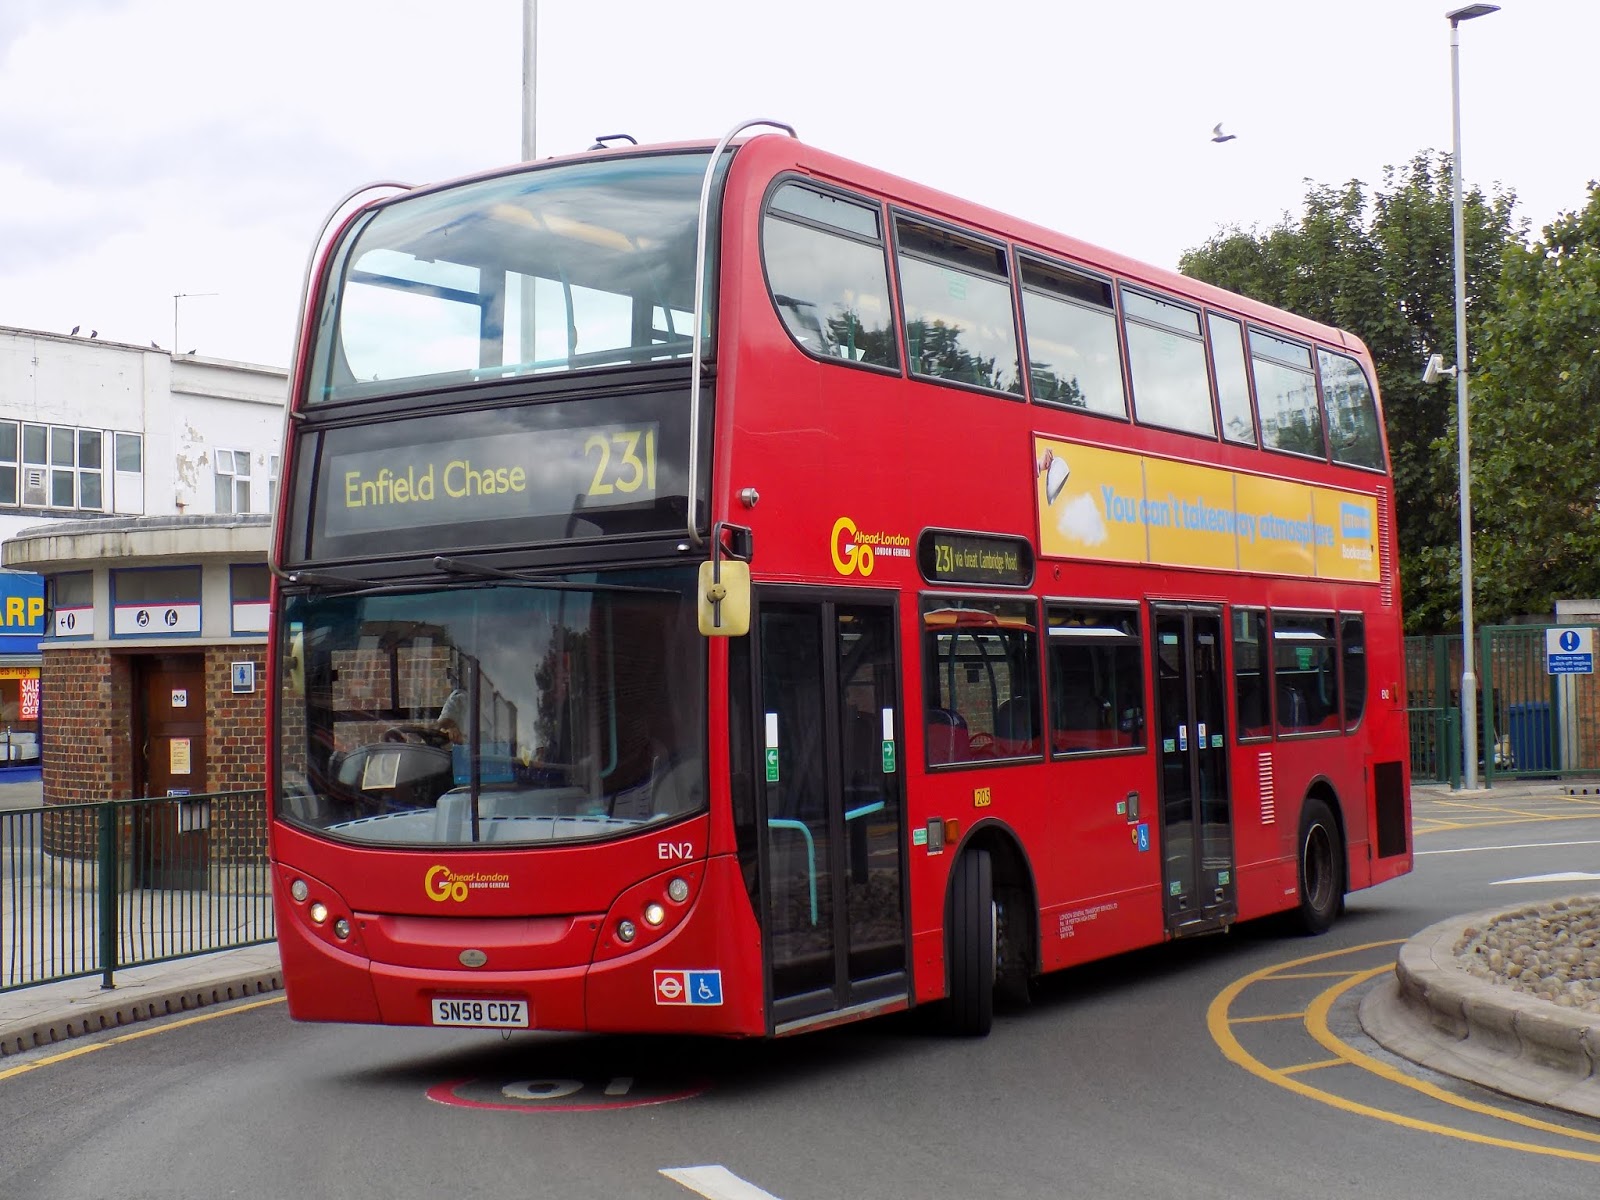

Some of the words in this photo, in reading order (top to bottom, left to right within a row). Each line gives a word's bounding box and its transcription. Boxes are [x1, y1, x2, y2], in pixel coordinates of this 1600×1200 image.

[584, 428, 657, 497] 231
[345, 464, 434, 508] Enfield
[443, 460, 526, 498] Chase
[1101, 484, 1136, 523] You
[1139, 492, 1181, 528] can't
[1182, 496, 1255, 544] takeaway
[831, 517, 874, 577] Go
[854, 531, 910, 546] Ahead-London
[874, 546, 892, 556] LONDON
[892, 548, 911, 558] GENERAL
[935, 545, 954, 572] 231
[955, 552, 963, 567] via
[964, 549, 978, 568] Great
[980, 550, 1004, 574] Cambridge
[1005, 552, 1018, 570] Road
[0, 597, 44, 627] RP
[22, 679, 39, 692] SALE
[22, 692, 39, 706] 20%
[22, 706, 39, 714] OFF
[977, 790, 990, 804] 205
[658, 842, 693, 859] EN2
[425, 865, 468, 902] Go
[440, 1002, 482, 1021] SN58
[488, 1003, 521, 1022] CDZ
